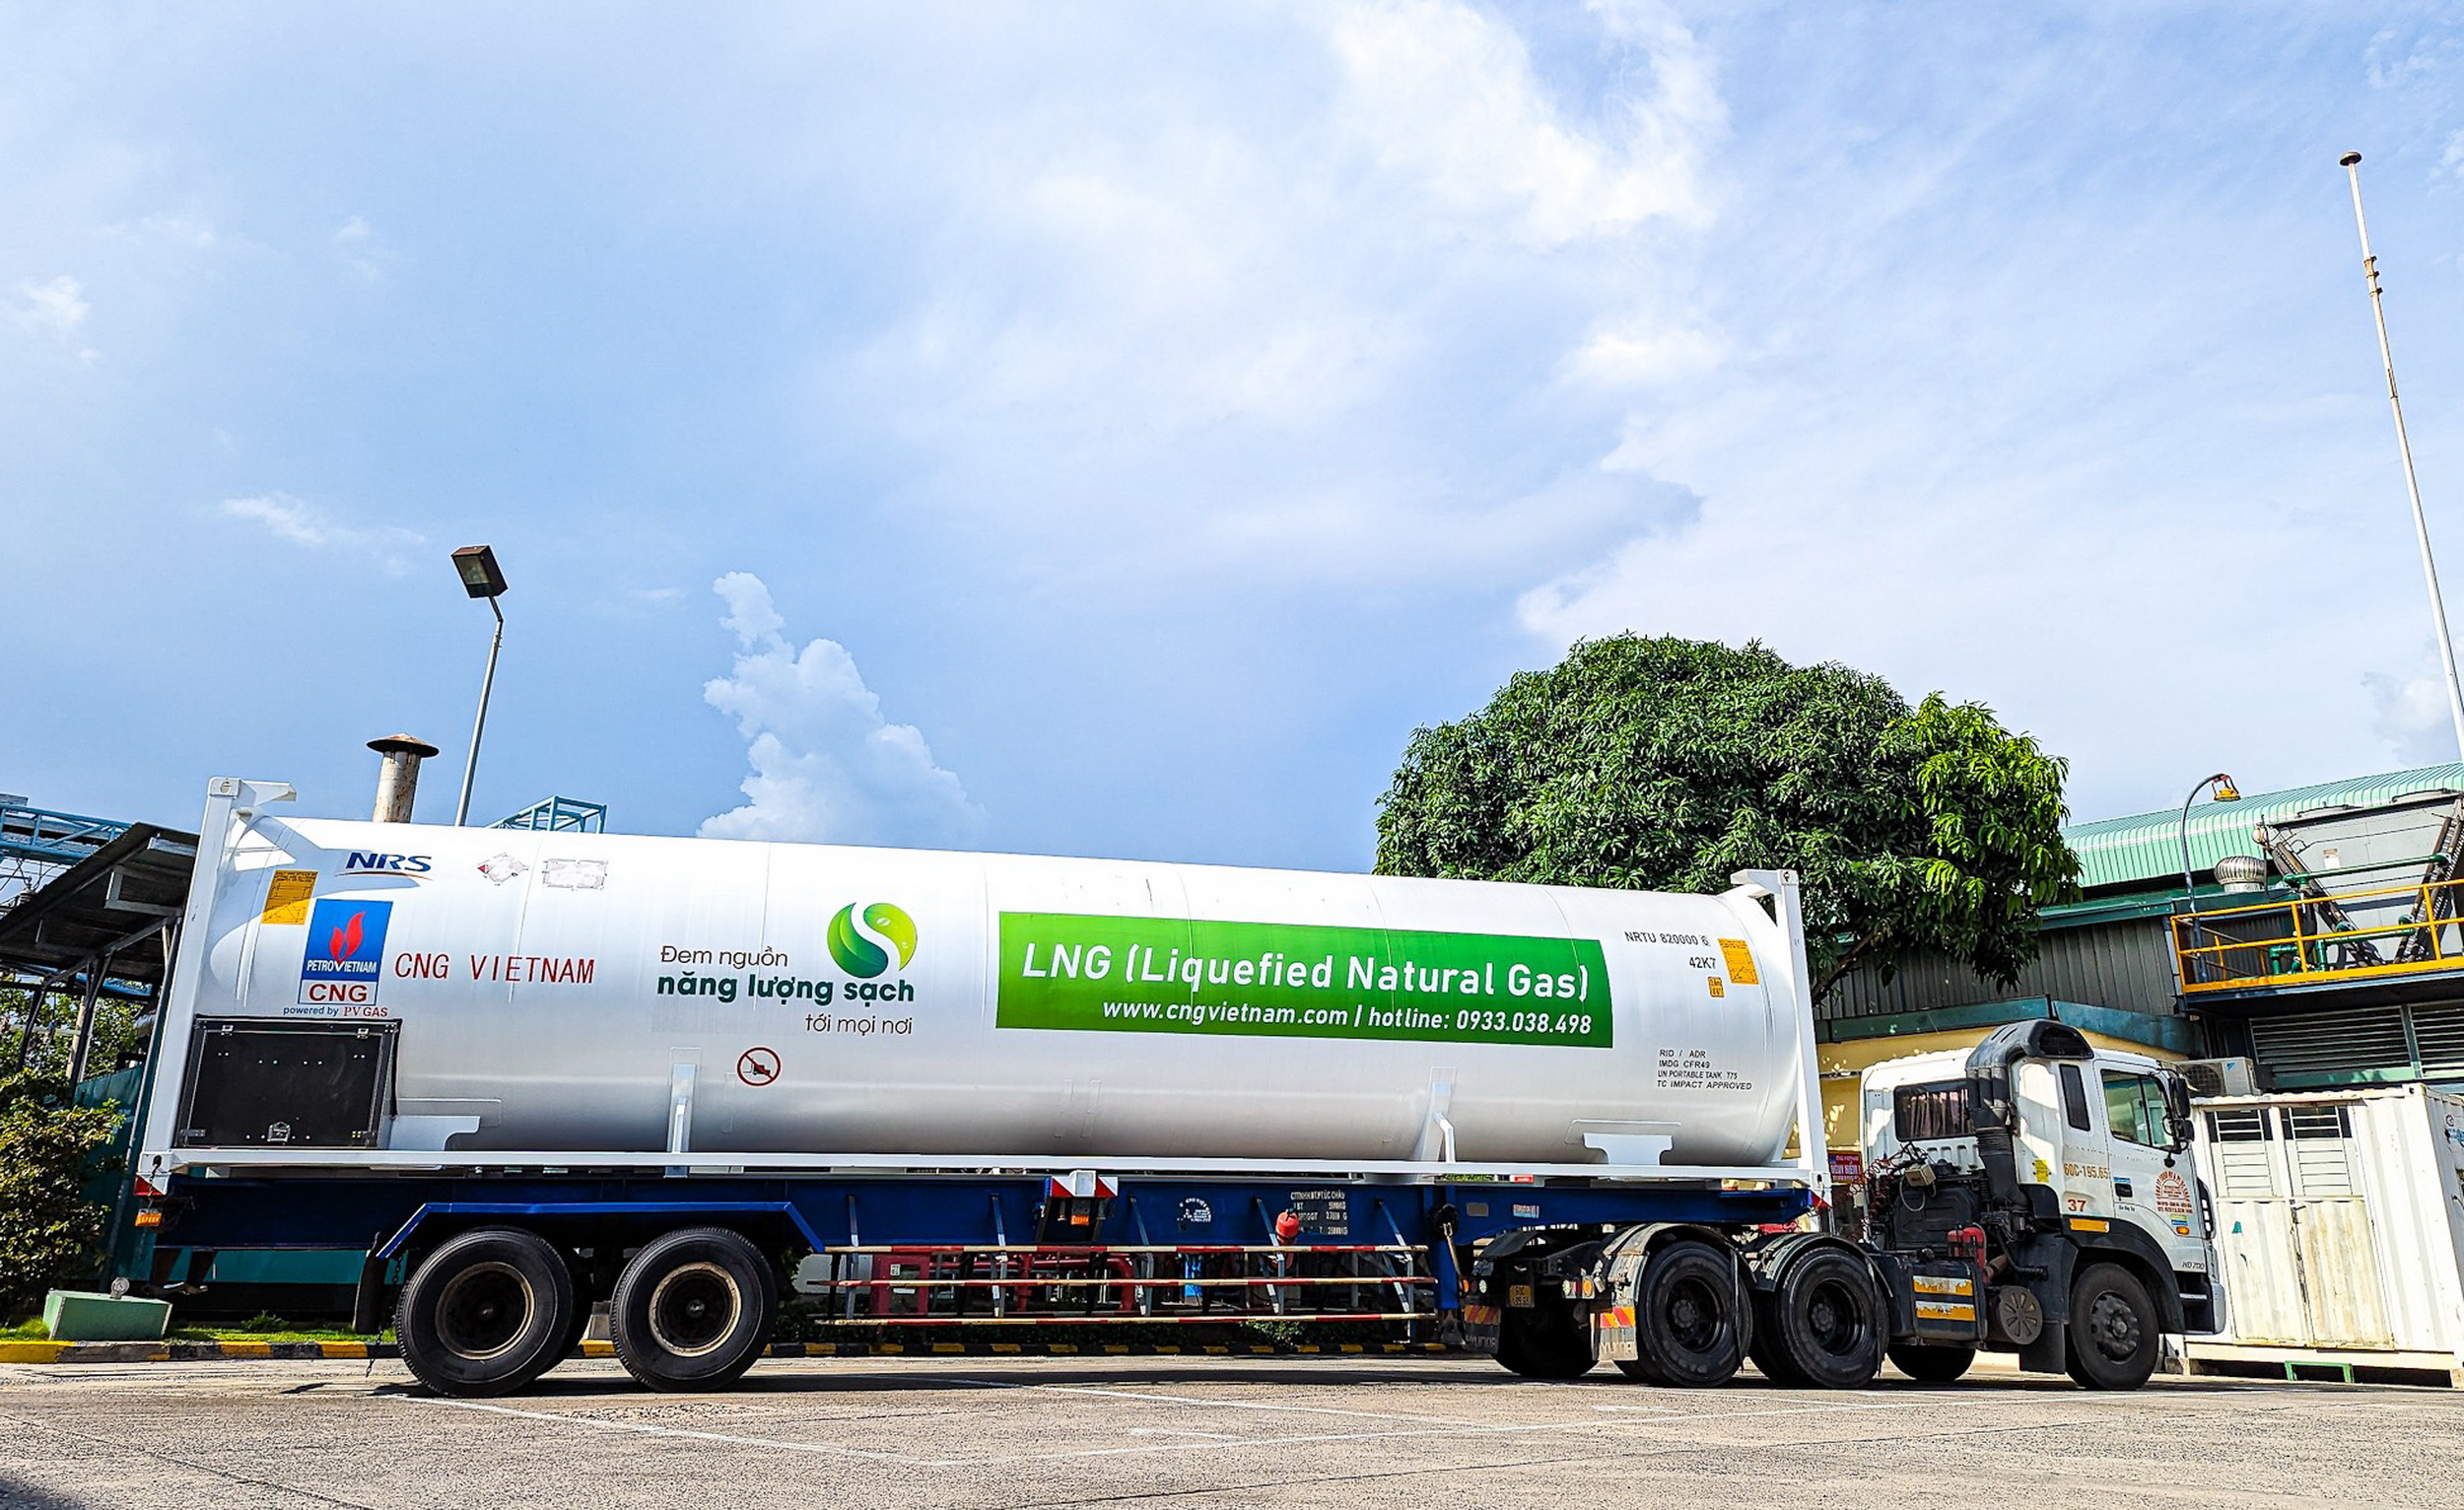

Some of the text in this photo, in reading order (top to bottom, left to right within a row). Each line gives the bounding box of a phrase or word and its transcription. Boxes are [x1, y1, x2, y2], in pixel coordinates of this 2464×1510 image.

[345, 852, 432, 872] NRS
[1624, 931, 1657, 943] NRTU
[1660, 932, 1699, 946] 820000
[306, 959, 377, 973] PETROVIETNAM
[660, 945, 788, 970] Đem nguồn
[394, 952, 595, 985] CNG VIETNAM
[1022, 942, 1589, 1002] LNG (Liquefied Natural Gas)
[308, 984, 368, 1003] CNG
[657, 971, 915, 1007] năng lượng sạch
[283, 1007, 325, 1016] powered
[327, 1007, 339, 1018] by
[1103, 1000, 1348, 1026] www.cngvietnam.com
[1368, 1007, 1451, 1030] hotline:
[1456, 1008, 1592, 1035] 0933.038.498
[805, 1014, 913, 1036] tới mọi nơi
[1659, 1049, 1675, 1058] RID
[1688, 1050, 1706, 1059] ADR
[1659, 1060, 1711, 1069] IMDG CFR49
[1657, 1069, 1668, 1078] UN
[1669, 1069, 1704, 1079] PORTABLE
[1670, 1080, 1703, 1089] IMPACT
[1705, 1081, 1753, 1090] APPROVED
[2067, 1199, 2088, 1212] 37
